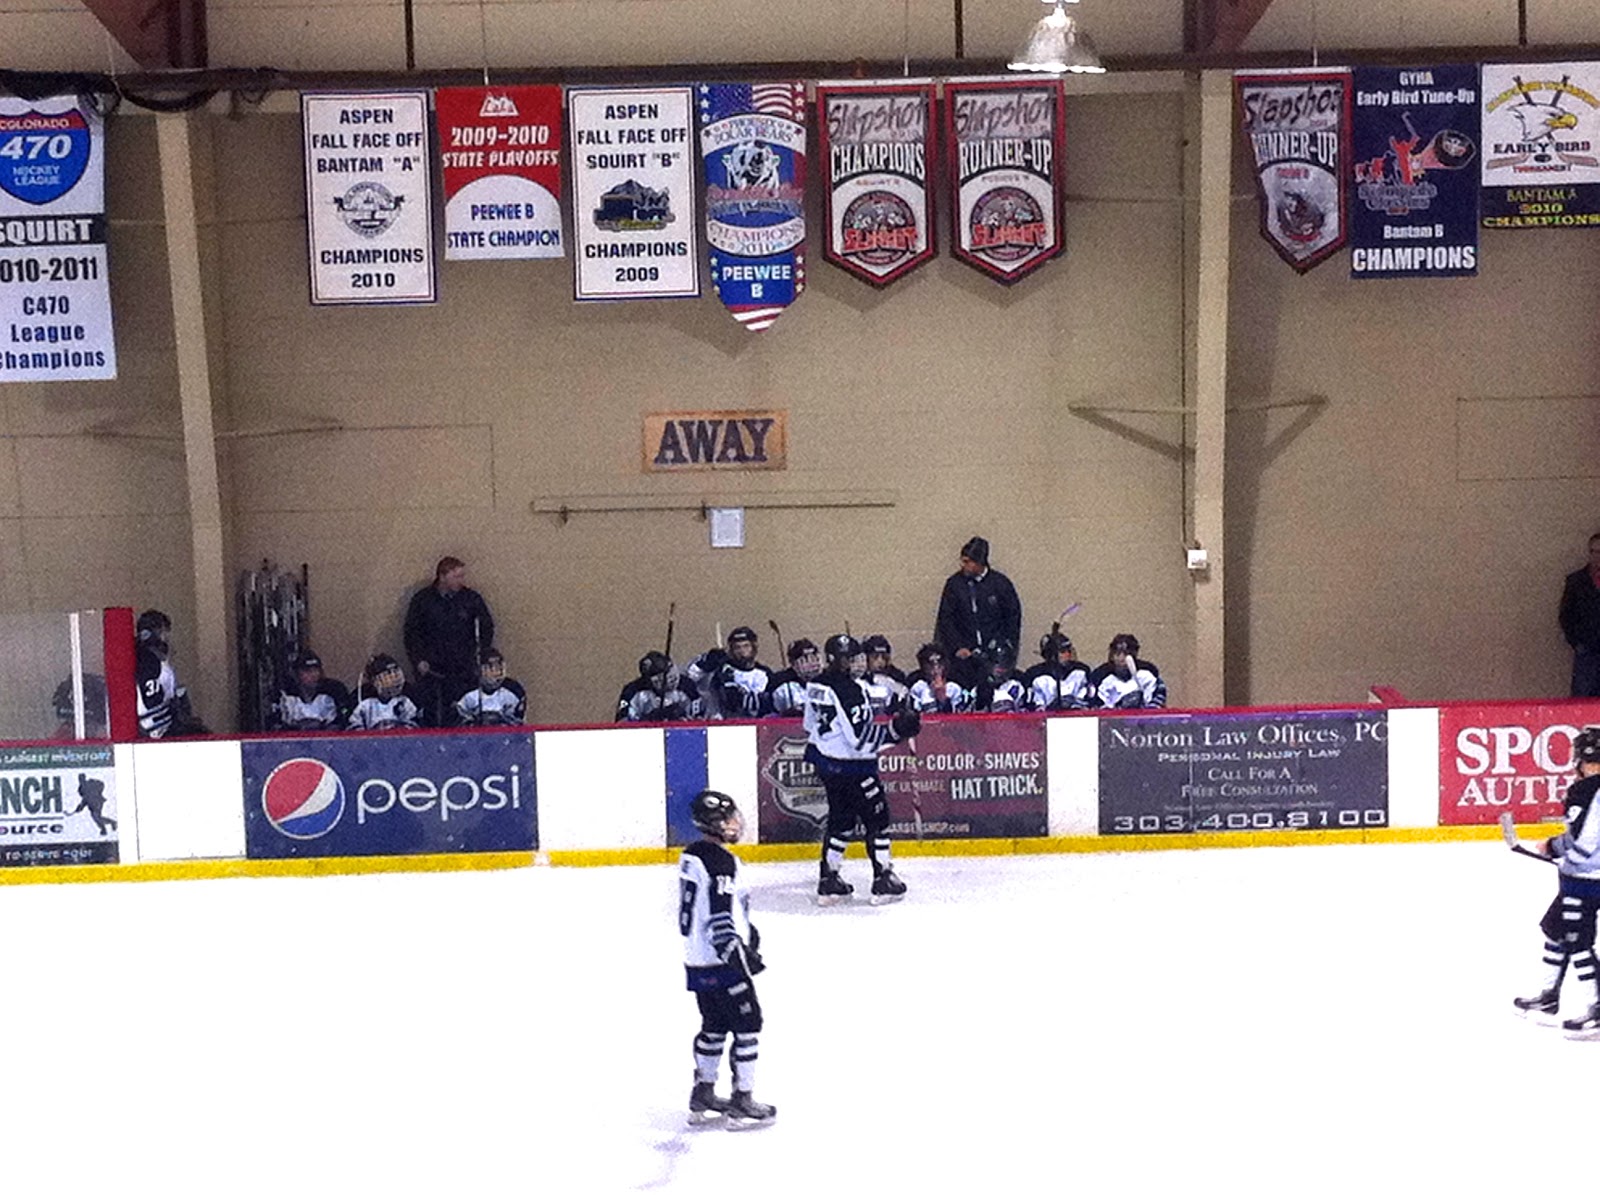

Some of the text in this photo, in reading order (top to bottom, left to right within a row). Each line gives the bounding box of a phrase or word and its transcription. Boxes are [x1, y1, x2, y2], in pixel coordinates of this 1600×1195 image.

[1357, 91, 1389, 107] Early
[1392, 90, 1419, 105] Bird
[1421, 89, 1475, 104] Tune-Up
[340, 109, 393, 124] ASPEN
[605, 104, 658, 120] ASPEN
[0, 118, 70, 130] COLORADO
[313, 132, 423, 149] FALL FACE OFF
[452, 126, 549, 146] 2009-2010
[578, 128, 687, 145] FALL FACE OFF
[0, 134, 72, 160] 470
[1494, 140, 1591, 154] EARLY BIRD
[317, 157, 420, 172] BANTAM "A"
[442, 150, 559, 168] STATE PLAYOFFS
[586, 152, 680, 169] SQUIRT "B"
[831, 143, 925, 182] CHAMPIONS
[959, 139, 1052, 178] RUNNER-UP
[13, 165, 60, 175] HOCKEY
[14, 175, 61, 186] LEAGUE
[1507, 189, 1565, 202] BANTAM
[471, 204, 535, 221] PEEWEE B
[1483, 214, 1600, 227] CHAMPIONS
[448, 229, 560, 248] STATE CHAMPION
[1384, 224, 1444, 239] Bantam B
[321, 248, 423, 264] CHAMPIONS
[585, 241, 687, 259] CHAMPIONS
[1353, 246, 1476, 272] CHAMPIONS
[0, 257, 98, 284] 010-2011
[615, 267, 659, 282] 2009
[723, 265, 790, 281] PEEWEE
[351, 273, 395, 288] 2010
[751, 283, 763, 297] B
[23, 296, 70, 316] C470
[11, 324, 85, 343] League
[0, 350, 105, 370] hampions
[654, 418, 775, 464] AWAY
[1110, 728, 1192, 748] Norton
[1204, 726, 1247, 746] Law
[1355, 721, 1388, 741] PC
[1158, 752, 1240, 762] PERSONAL
[1247, 750, 1301, 760] INJURY
[1456, 725, 1582, 775] SPO
[927, 754, 974, 771] COLOR
[985, 753, 1039, 769] SHAVES
[1279, 766, 1291, 779] A
[0, 776, 63, 814] NCH
[357, 765, 520, 824] pepsi
[951, 778, 985, 800] HAT
[1457, 775, 1577, 806] AUTH
[0, 823, 63, 835] ource
